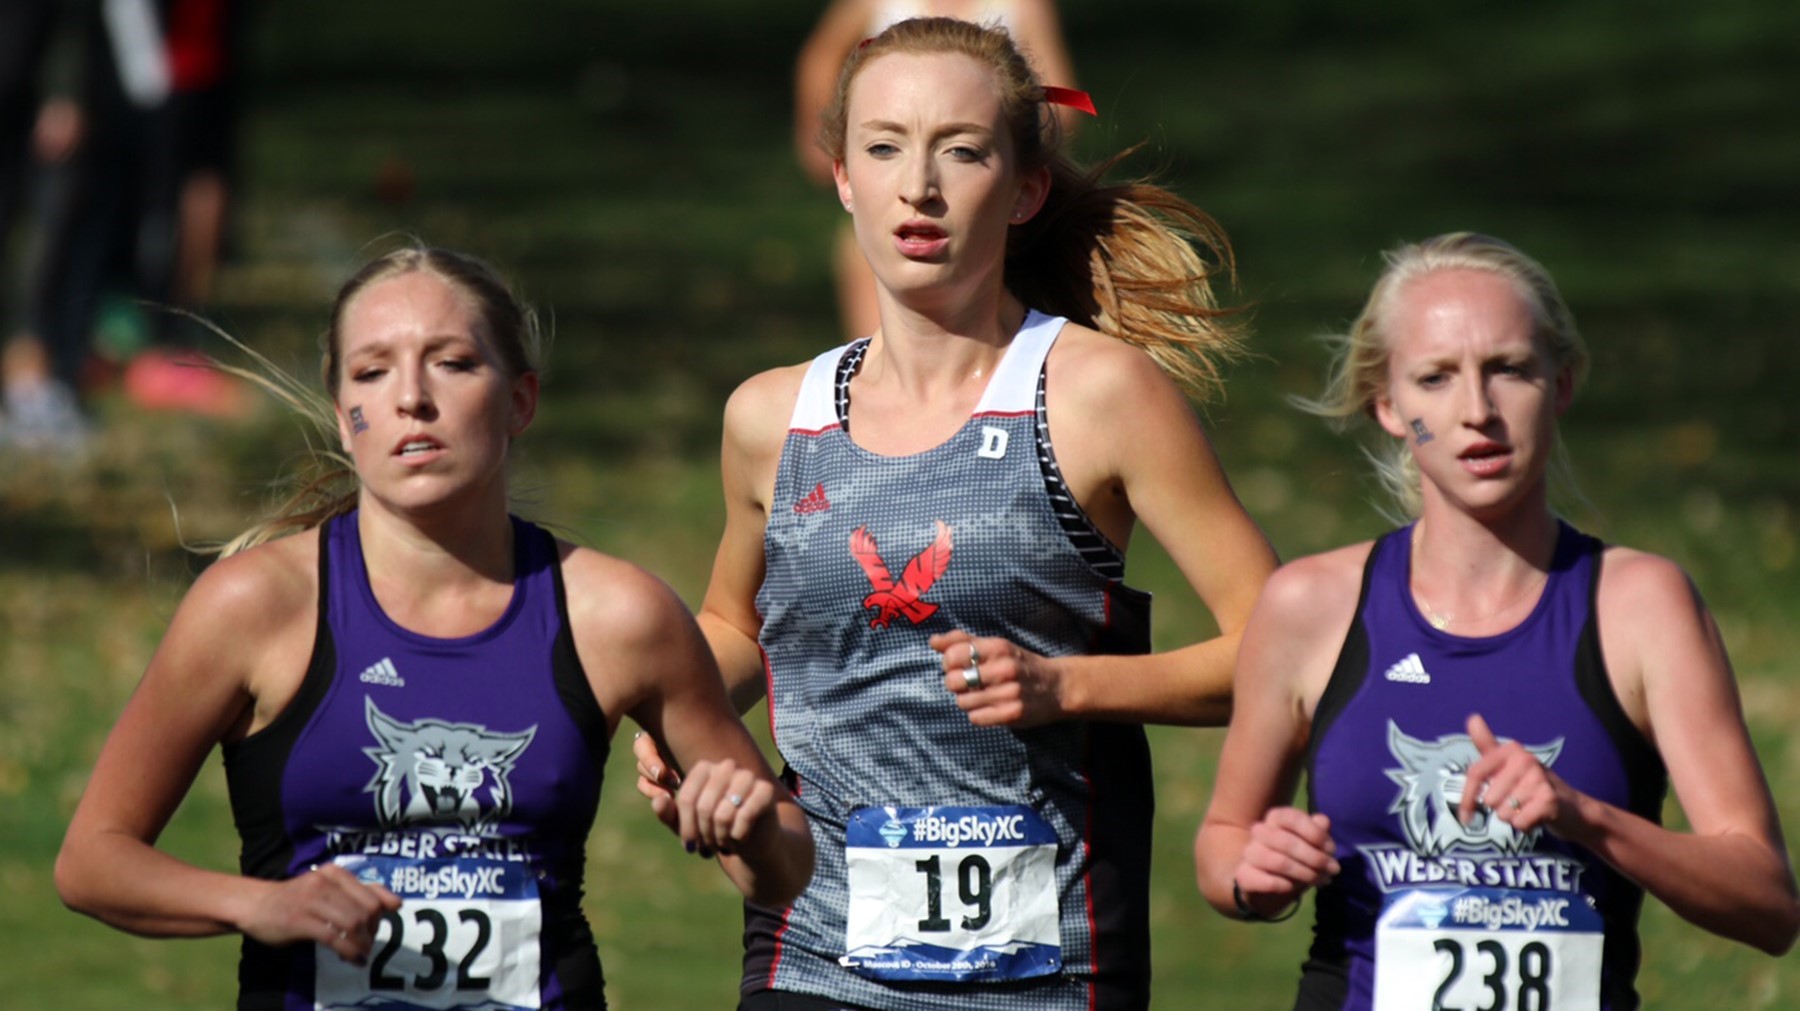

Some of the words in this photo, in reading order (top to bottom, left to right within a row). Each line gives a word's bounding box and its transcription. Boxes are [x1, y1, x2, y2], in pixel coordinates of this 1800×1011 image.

[978, 425, 1009, 460] D
[360, 672, 405, 688] adidas
[1384, 669, 1431, 684] adidas
[914, 814, 1024, 847] #BigSkyXC
[391, 866, 505, 899] #BigSkyXC
[1376, 850, 1480, 886] WEBER
[1481, 857, 1571, 891] STATE
[914, 854, 992, 933] 19
[1454, 895, 1570, 931] #BigSkyXC
[369, 908, 492, 992] 232
[916, 960, 951, 970] October
[1431, 938, 1553, 1011] 238
